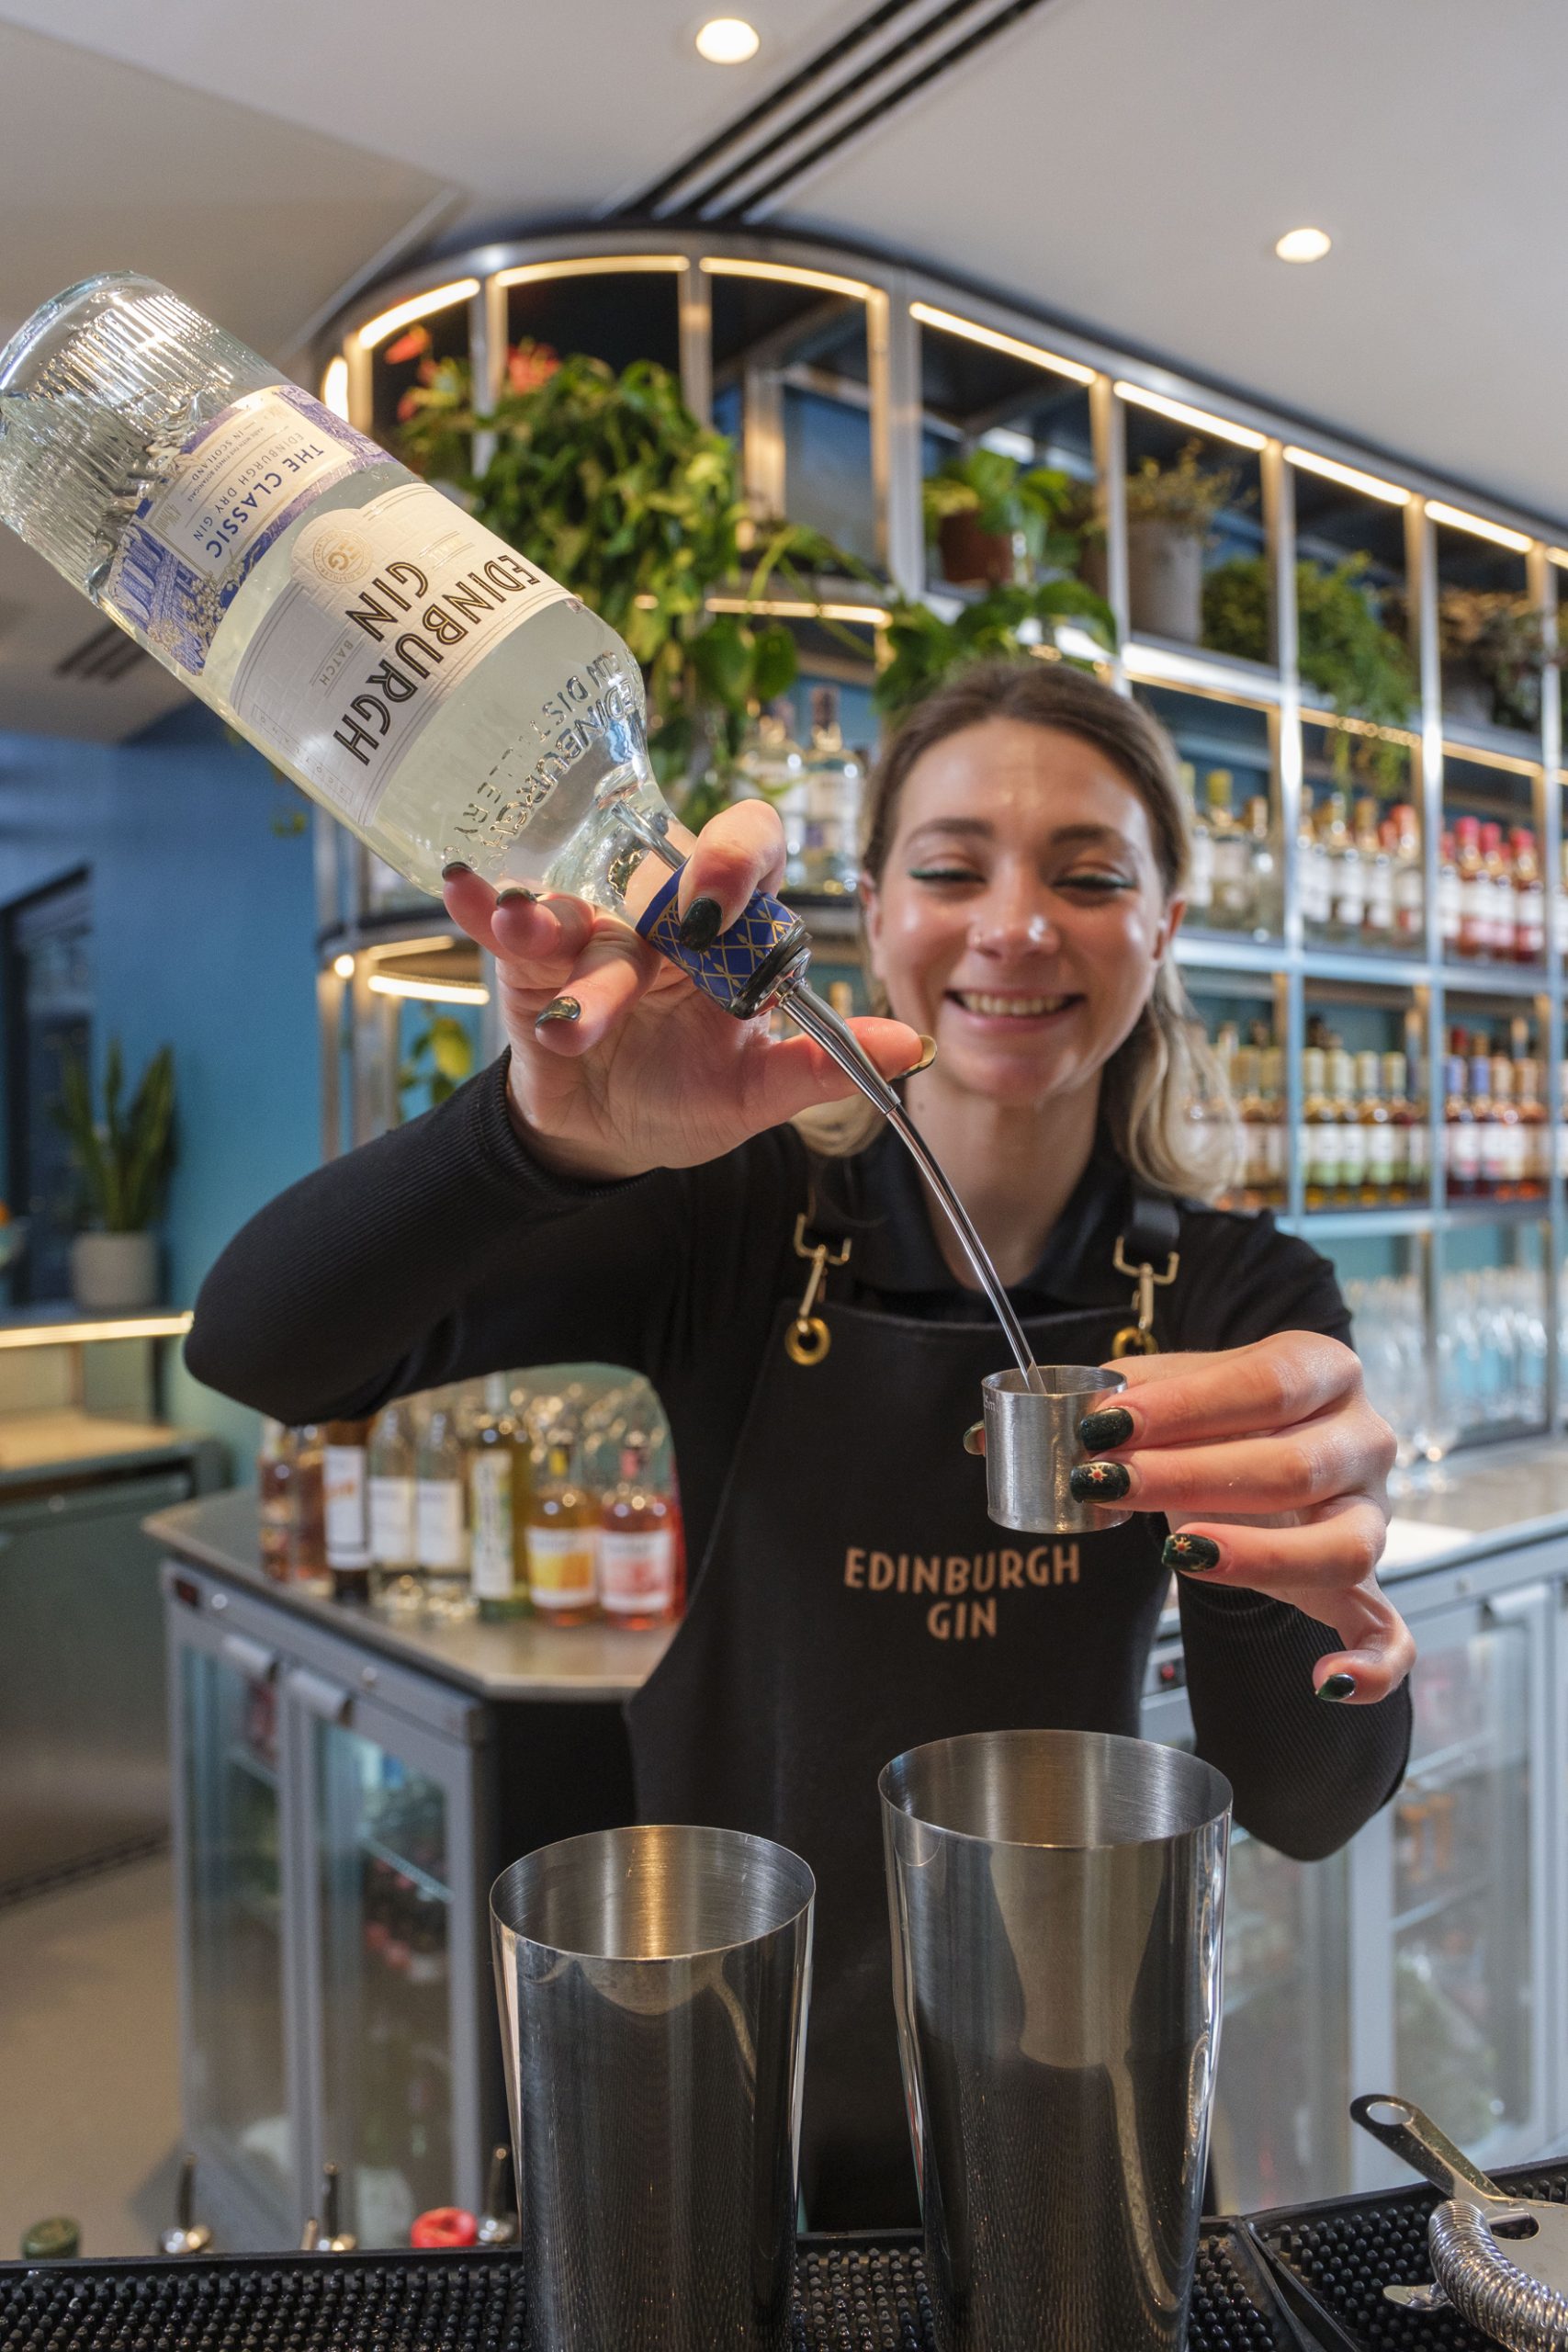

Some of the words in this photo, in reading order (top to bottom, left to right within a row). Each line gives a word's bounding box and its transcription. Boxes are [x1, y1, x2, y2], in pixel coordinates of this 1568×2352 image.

[232, 430, 243, 439] IN
[192, 440, 231, 480] SCOTLAND
[237, 431, 303, 487] EDINBURGH
[281, 443, 324, 473] THE
[204, 472, 280, 559] CLASSIC
[215, 487, 238, 514] DRY
[192, 515, 214, 541] GIN
[345, 561, 428, 643] GIN
[317, 639, 354, 685] BATCH
[331, 554, 539, 766] EDINBURGH
[480, 679, 635, 850] EDINBURGH
[844, 1543, 1080, 1595] EDINBURGH
[927, 1598, 997, 1640] GIN
